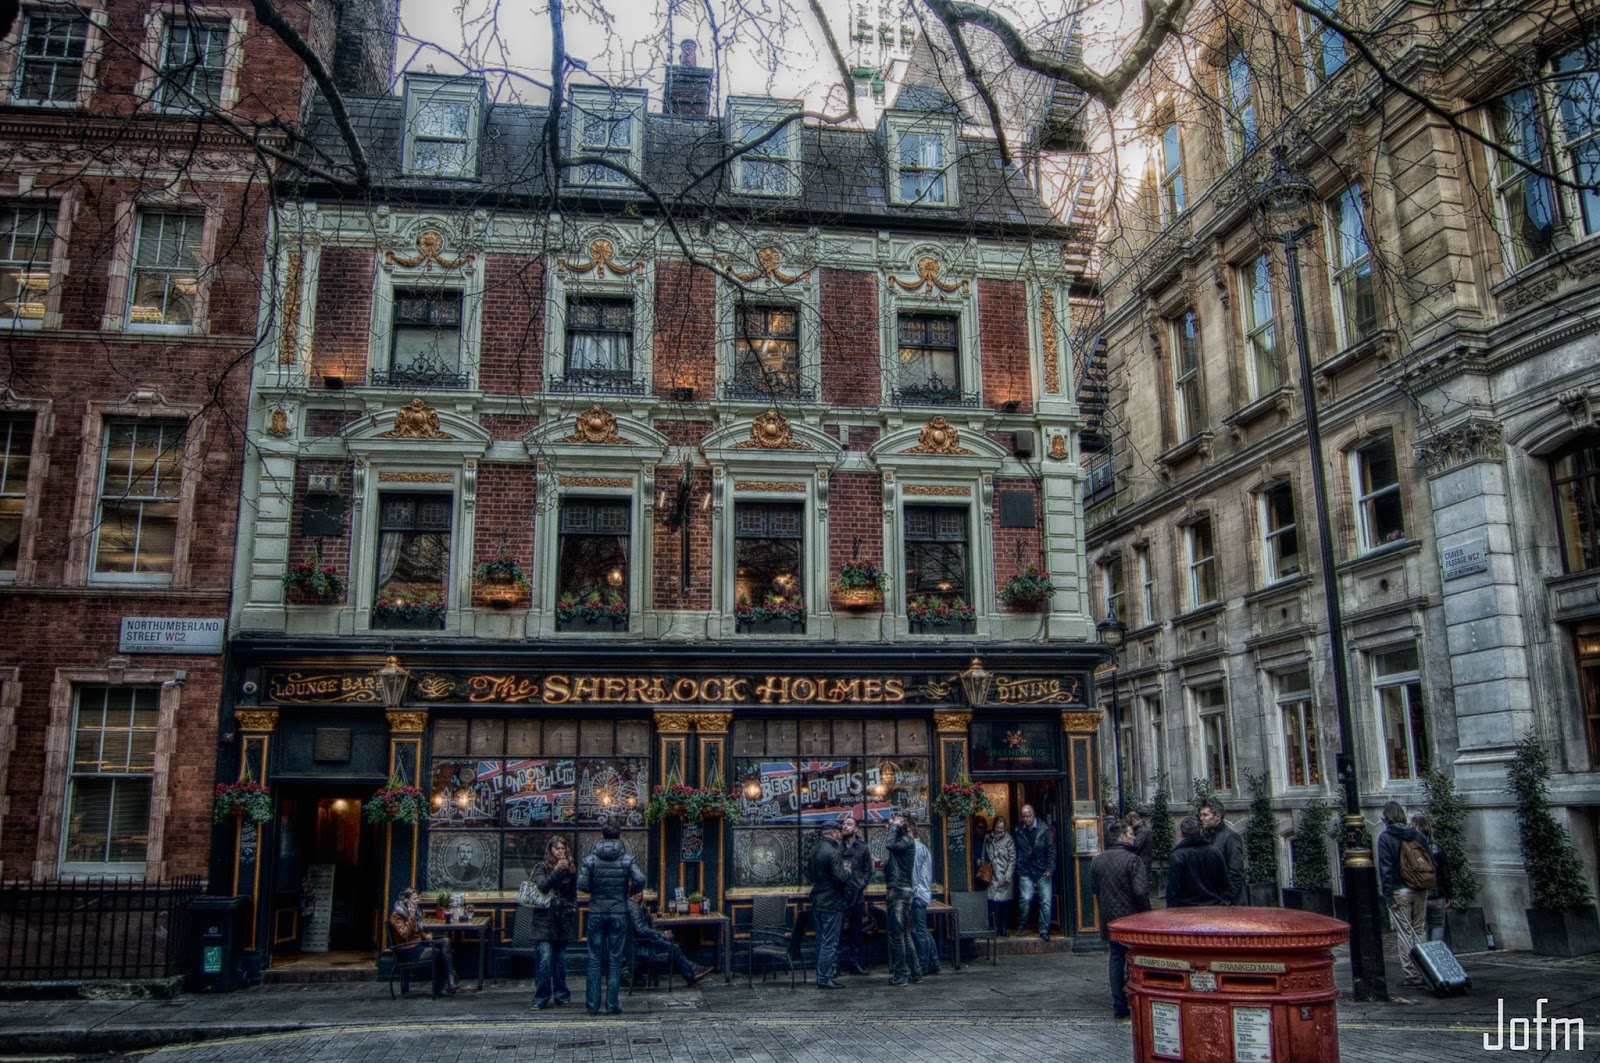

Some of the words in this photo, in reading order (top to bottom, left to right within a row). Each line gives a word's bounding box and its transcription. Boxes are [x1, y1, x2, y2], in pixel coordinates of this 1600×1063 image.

[1467, 552, 1480, 562] WC2
[127, 620, 219, 631] NORTHUMBERLAND
[126, 631, 161, 641] STREET
[165, 632, 186, 642] WC2
[275, 680, 338, 696] LOUNGE
[342, 677, 375, 690] BAR
[468, 674, 539, 702] The
[543, 675, 747, 704] SHERLOCK
[756, 675, 906, 703] HOLMES
[998, 679, 1061, 700] DINING
[492, 765, 546, 794] LONDON
[808, 768, 881, 803] BRITISH
[760, 775, 799, 802] BEST
[1139, 957, 1165, 967] STAMPED
[1166, 961, 1182, 969] MAIL
[1219, 963, 1256, 972] FRANKED
[1258, 964, 1278, 972] MAIL
[1281, 974, 1322, 989] OFFICE
